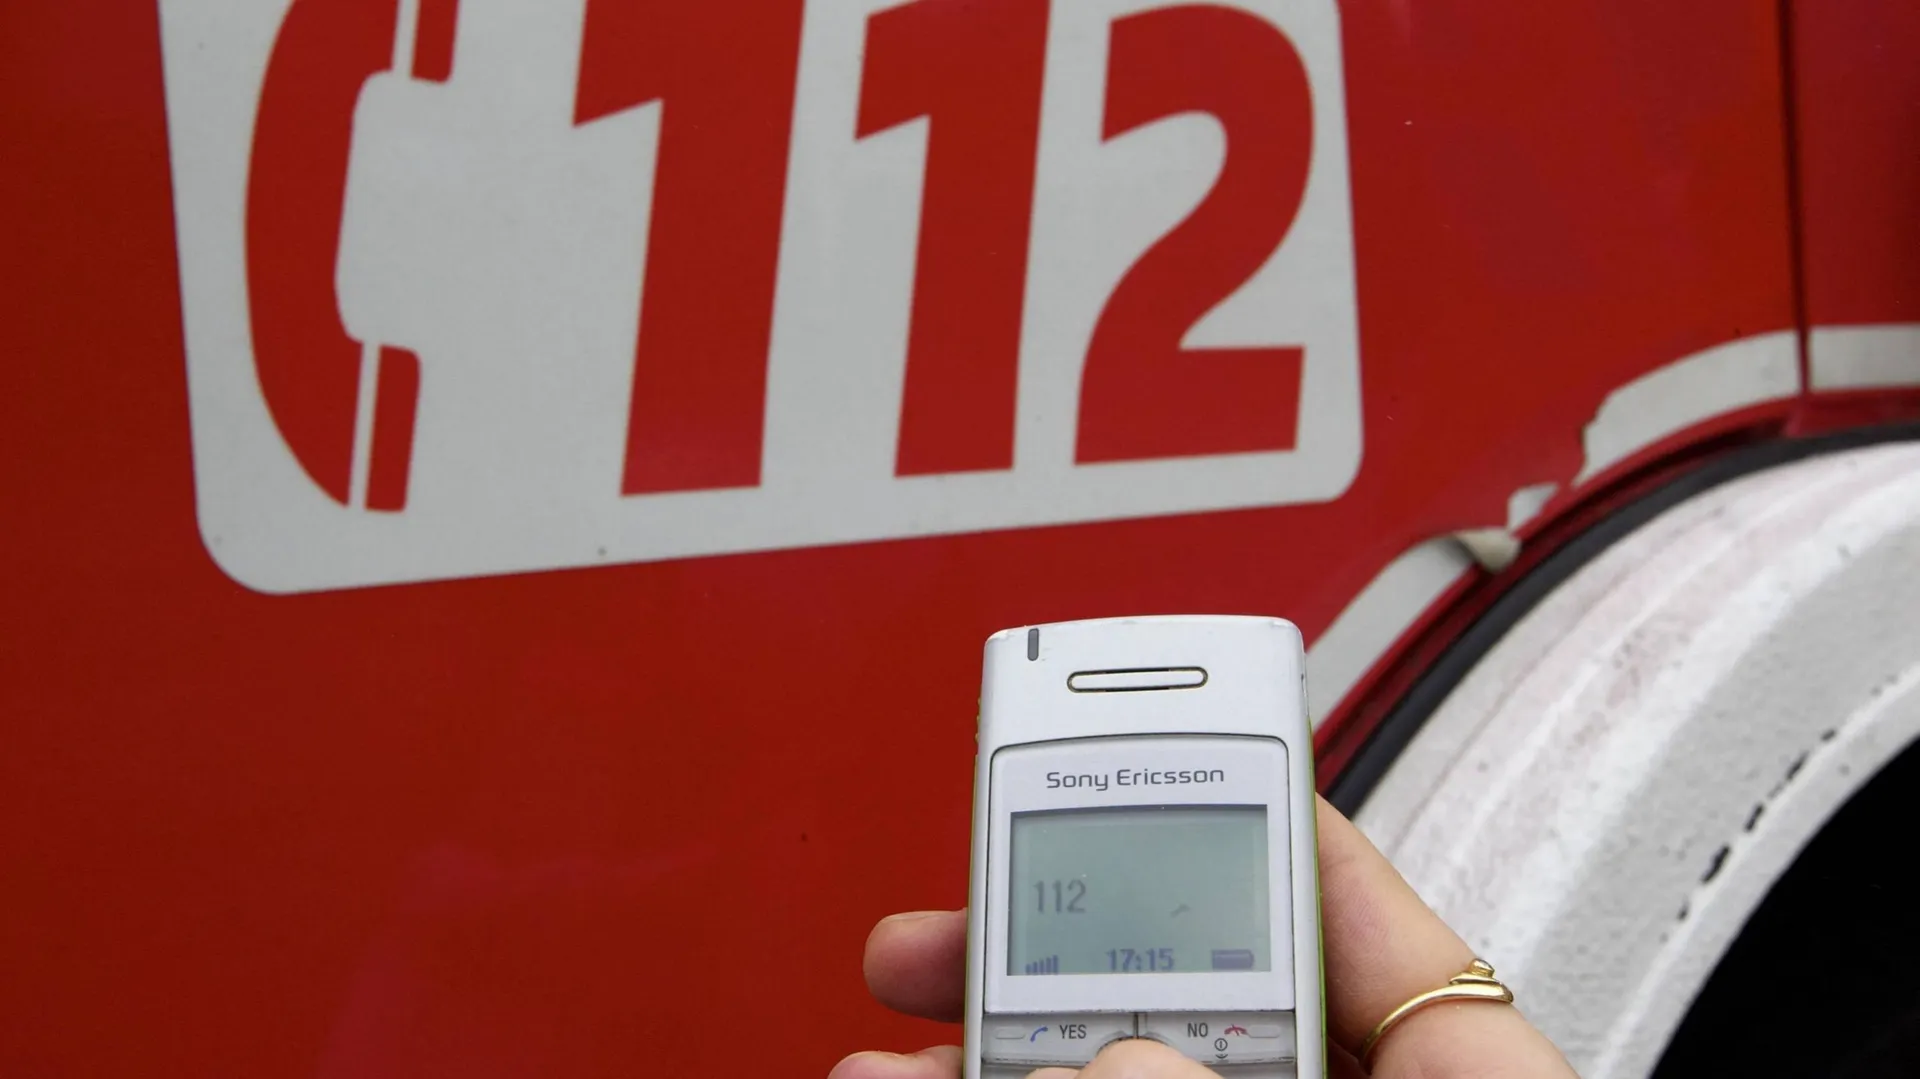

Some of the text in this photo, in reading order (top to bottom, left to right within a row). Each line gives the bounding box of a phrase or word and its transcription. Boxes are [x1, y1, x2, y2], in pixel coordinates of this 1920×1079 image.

[573, 0, 1315, 497] 112
[1046, 768, 1225, 792] Sony Ericsson
[1033, 879, 1087, 915] 112
[1105, 948, 1175, 972] 17:15
[1059, 1024, 1087, 1040] YES
[1187, 1022, 1209, 1038] NO
